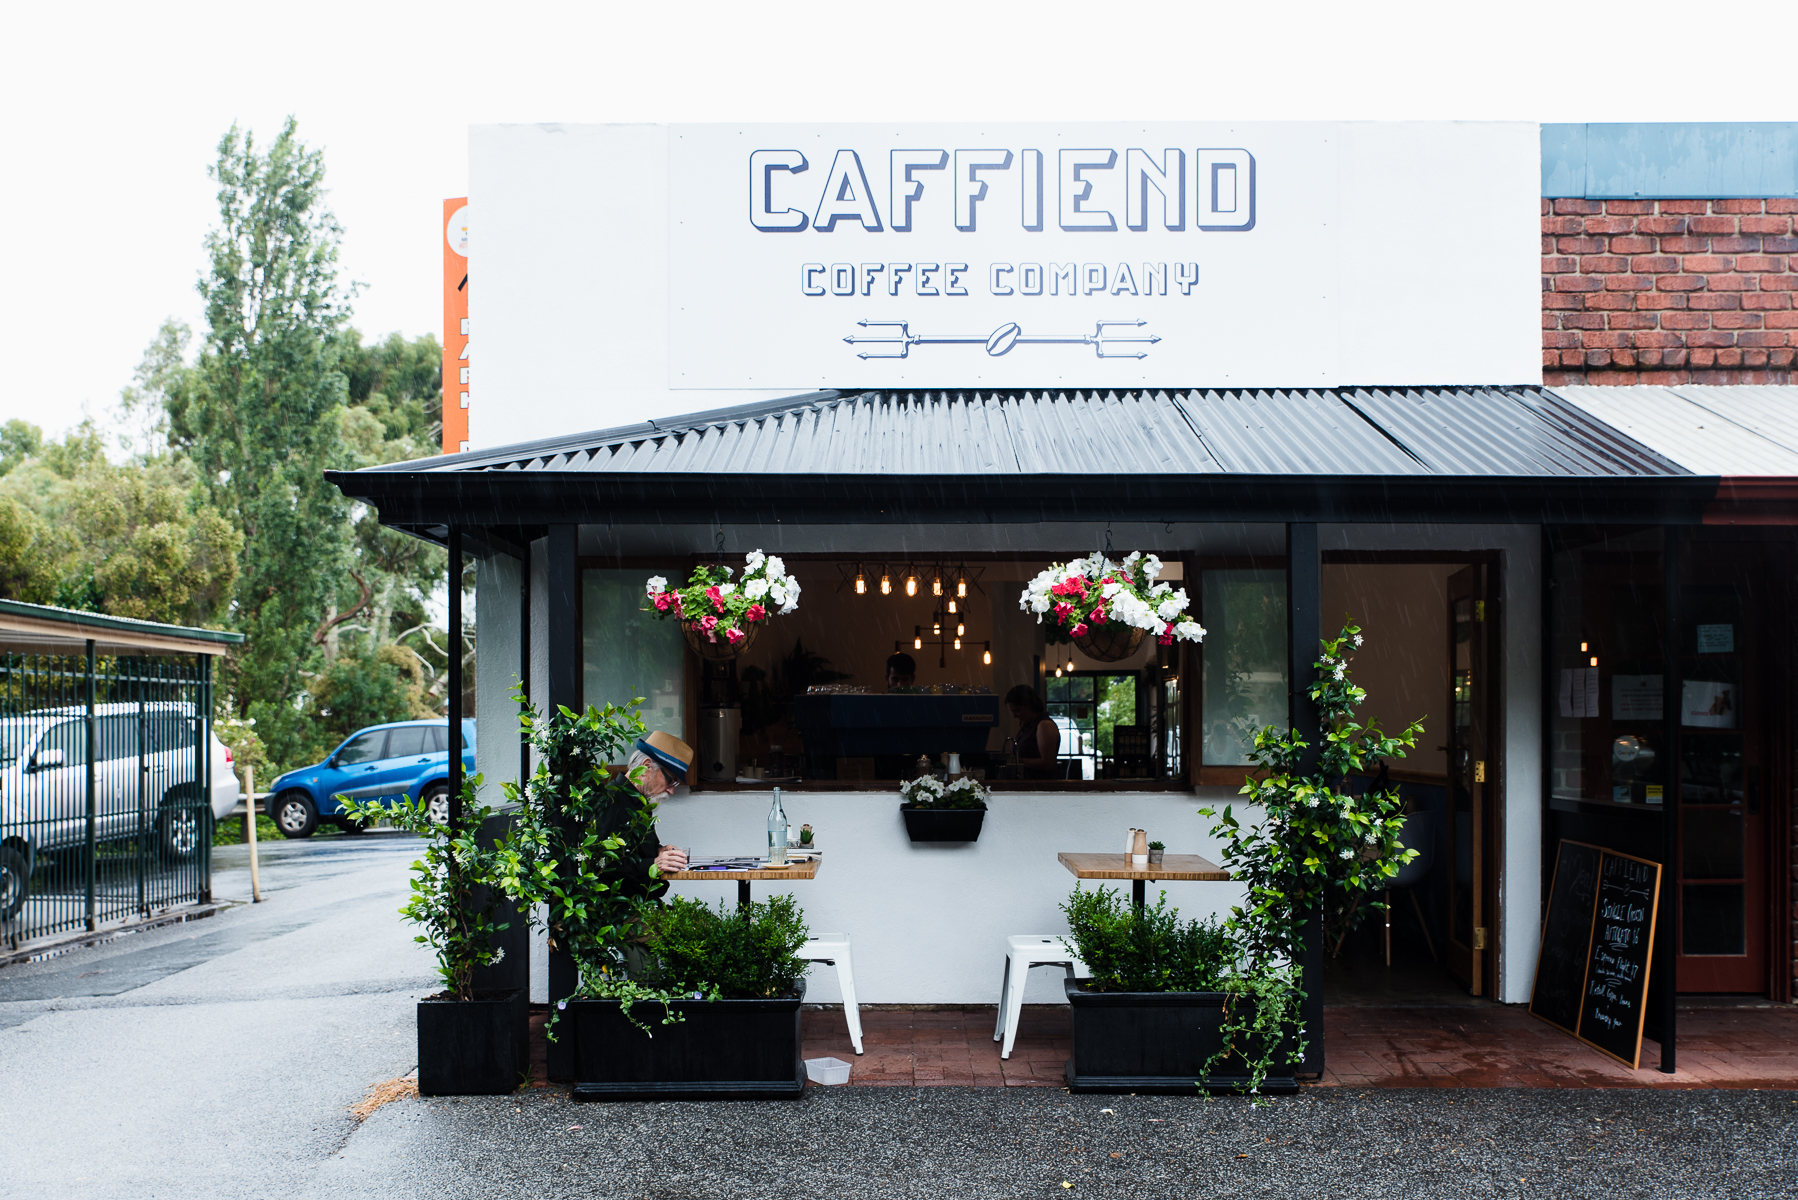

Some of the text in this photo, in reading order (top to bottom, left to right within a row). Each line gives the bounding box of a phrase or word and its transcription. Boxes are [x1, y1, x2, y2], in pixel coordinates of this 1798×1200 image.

[750, 148, 1257, 232] CAFFIEND
[801, 262, 1199, 297] COFFEE COMPANY
[1603, 857, 1649, 883] CAFFIEND
